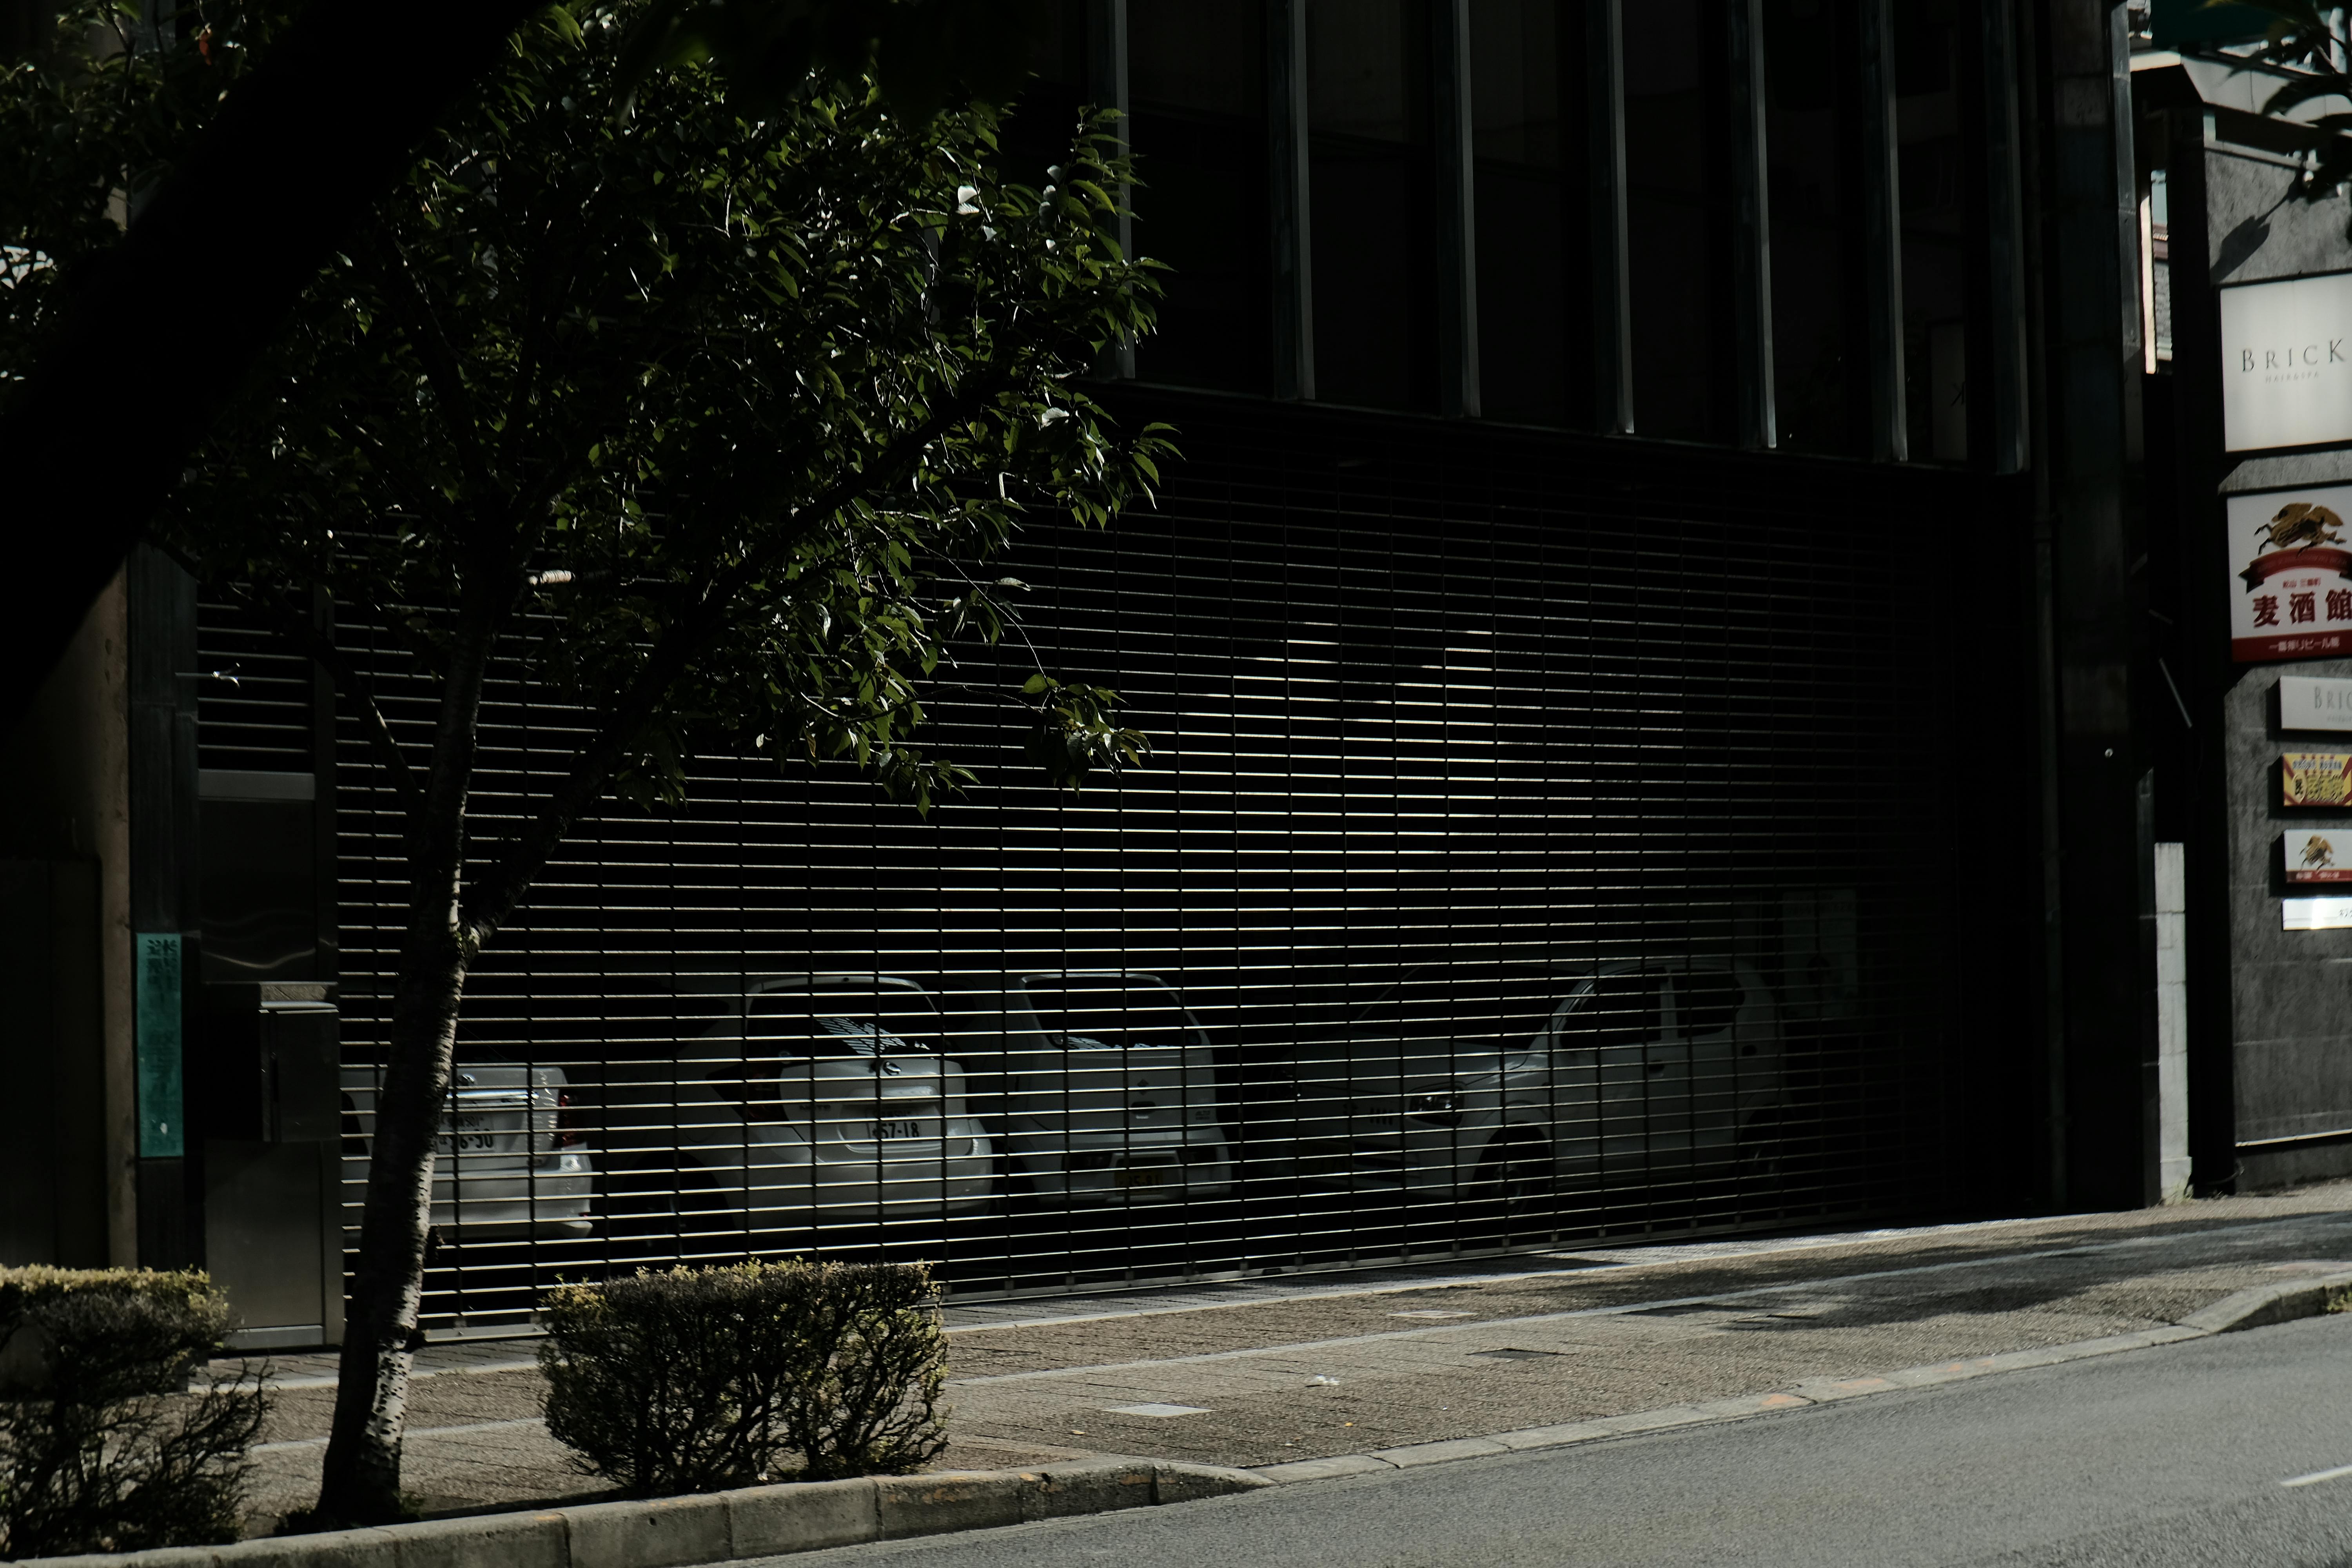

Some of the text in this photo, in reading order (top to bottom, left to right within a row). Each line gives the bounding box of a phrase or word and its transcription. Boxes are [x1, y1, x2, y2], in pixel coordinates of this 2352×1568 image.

[2242, 339, 2345, 372] BRICK
[2253, 588, 2352, 628] 麦酒館
